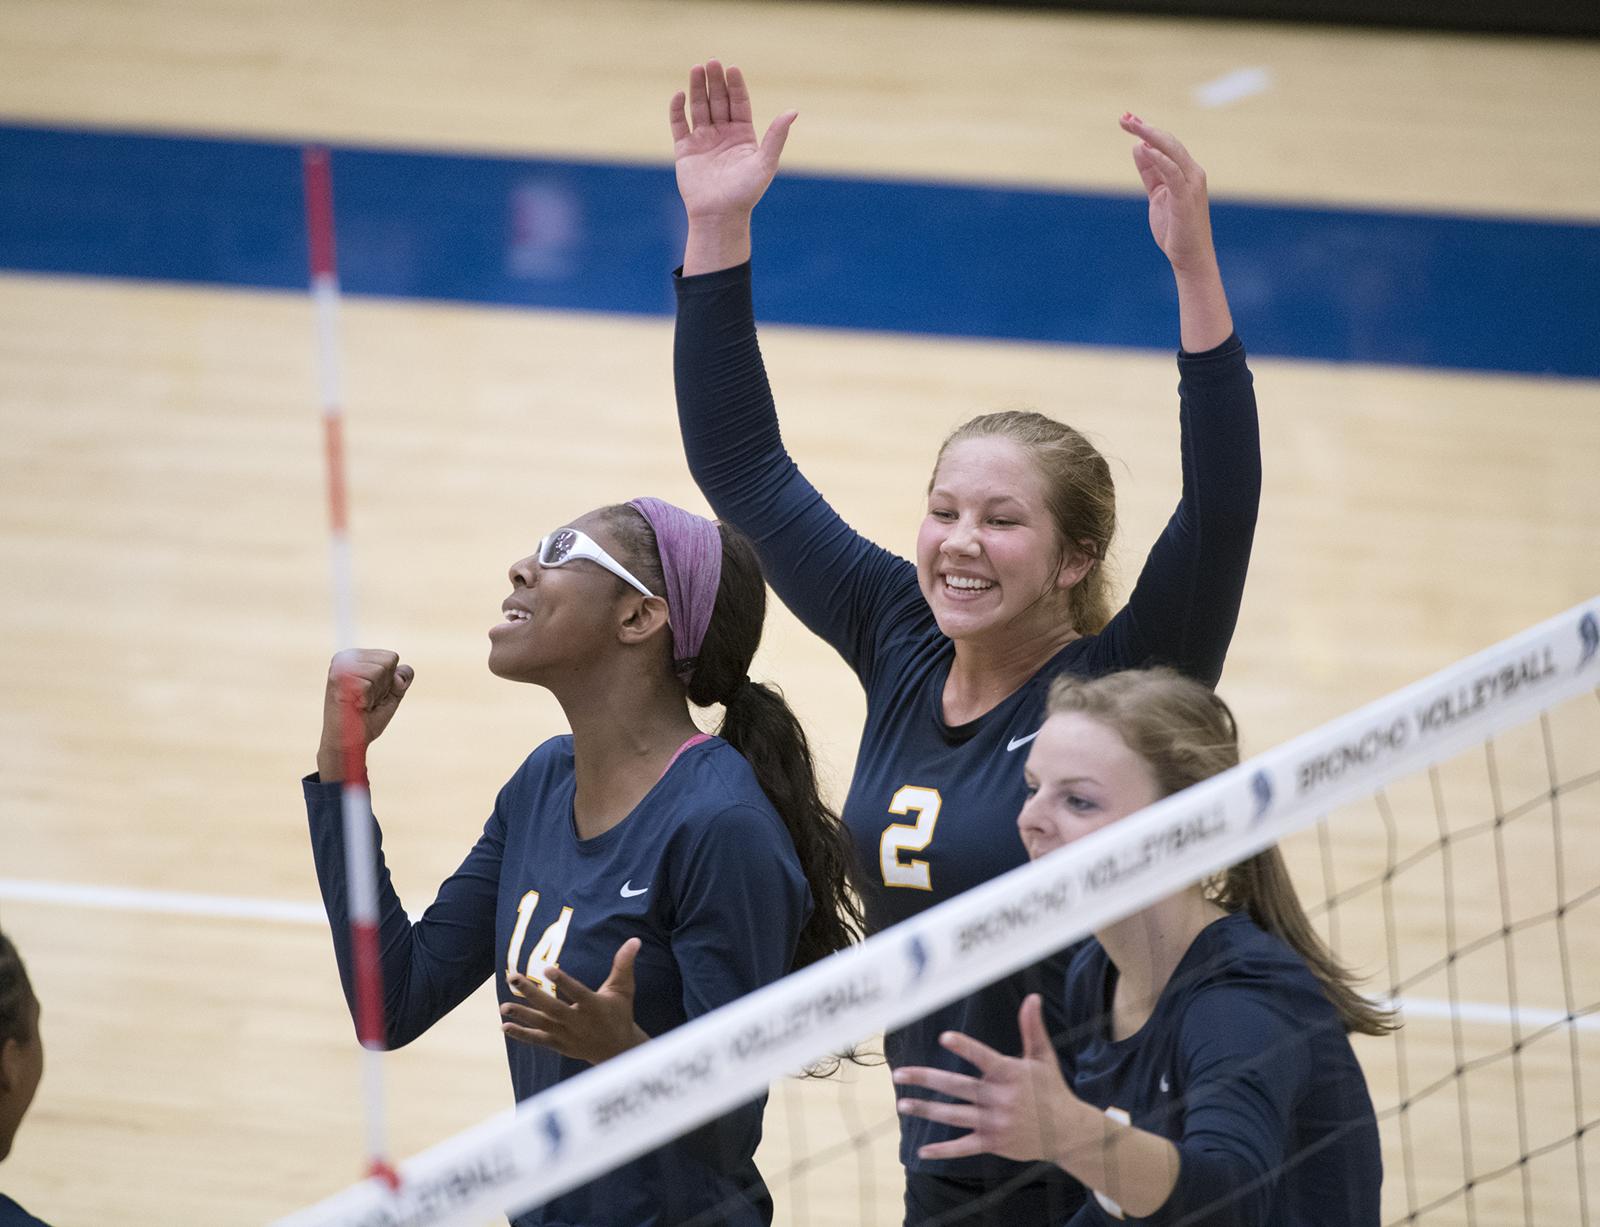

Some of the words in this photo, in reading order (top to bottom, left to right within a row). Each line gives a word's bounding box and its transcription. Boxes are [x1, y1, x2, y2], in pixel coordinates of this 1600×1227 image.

[1296, 716, 1410, 788] BRONCHO
[1414, 646, 1557, 734] VOLLEYBALL
[880, 785, 942, 891] 2
[957, 880, 1069, 950] BRONCHO
[1080, 802, 1228, 894] VOLLEYBALL
[506, 890, 574, 999] 14
[728, 972, 884, 1058] VOLLEYBALL
